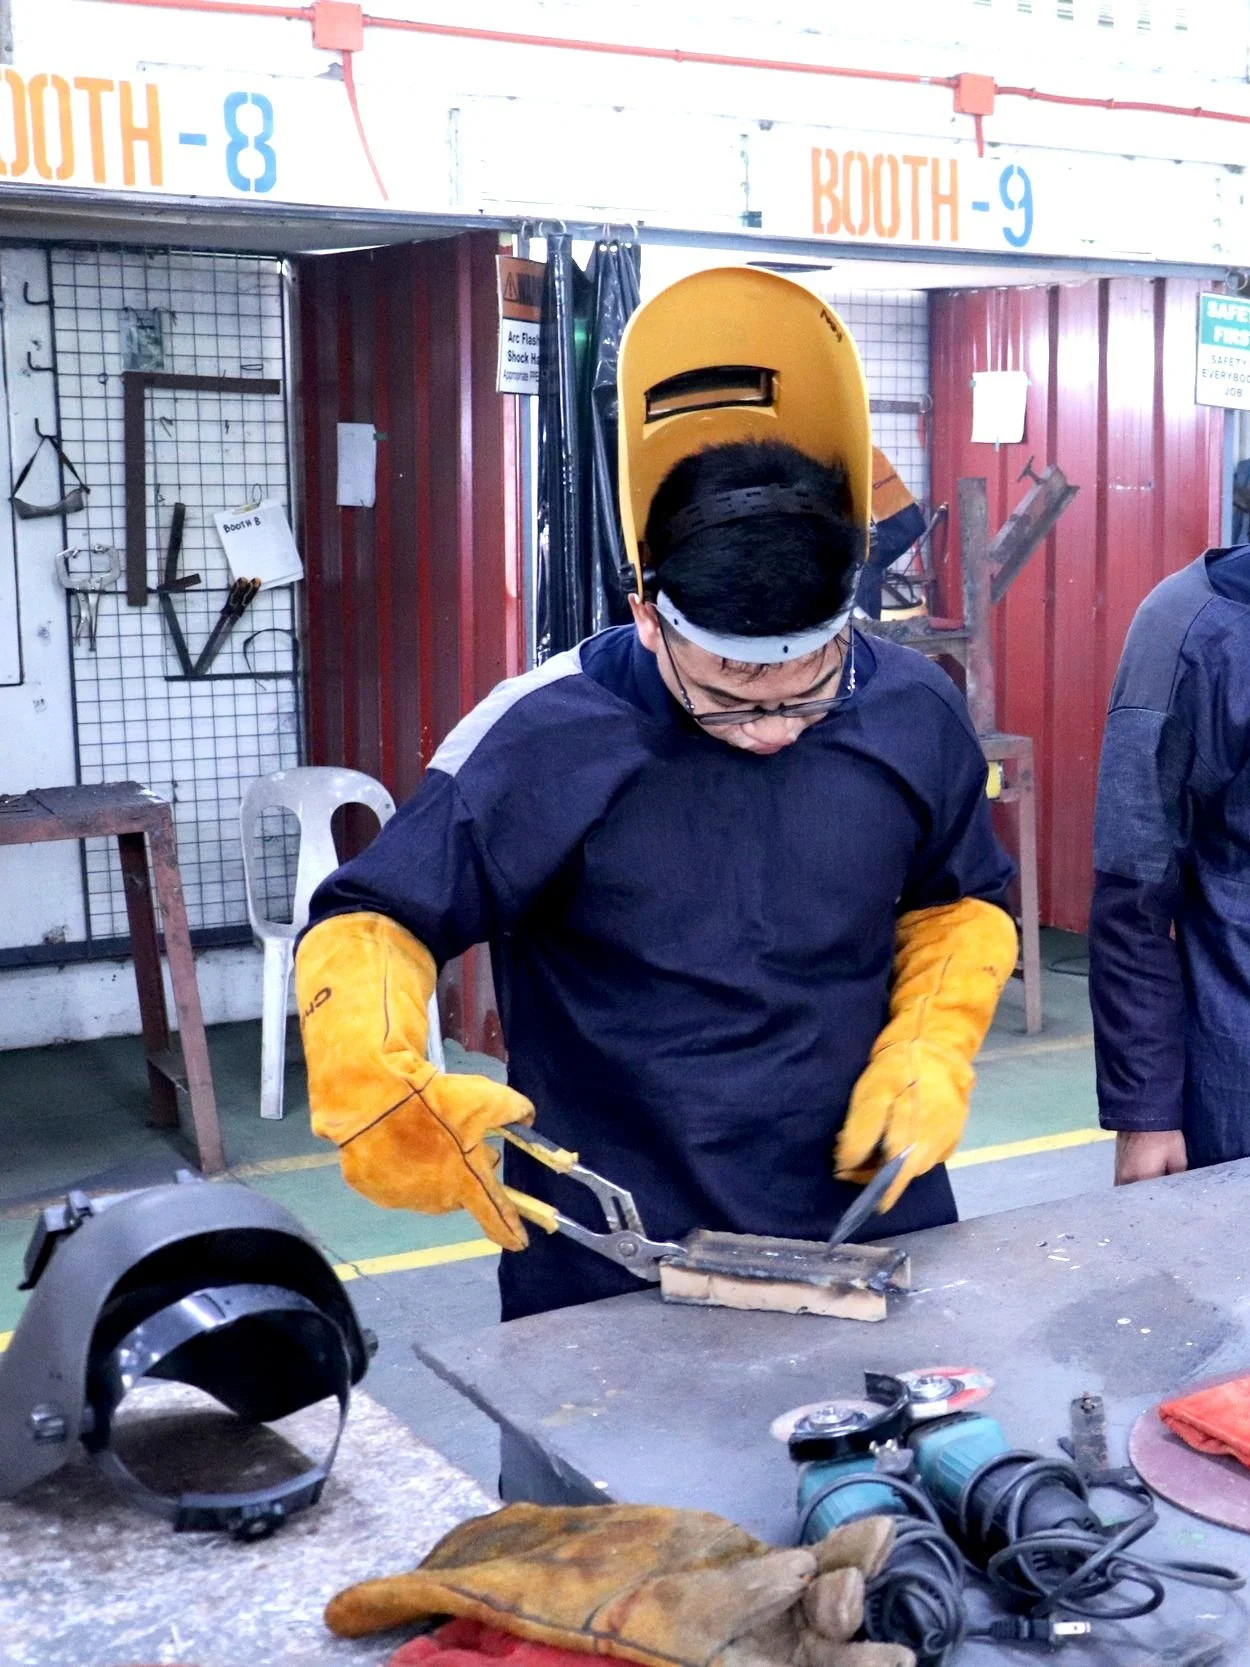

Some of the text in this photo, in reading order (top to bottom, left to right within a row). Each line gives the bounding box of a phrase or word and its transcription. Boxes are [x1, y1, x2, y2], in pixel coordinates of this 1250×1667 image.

[0, 69, 277, 193] OOTH-8
[508, 330, 520, 344] Arc
[507, 350, 540, 366] Shock Ha
[1212, 355, 1246, 367] SAFETY
[1224, 387, 1243, 398] JOB
[223, 519, 253, 533] BOOTH
